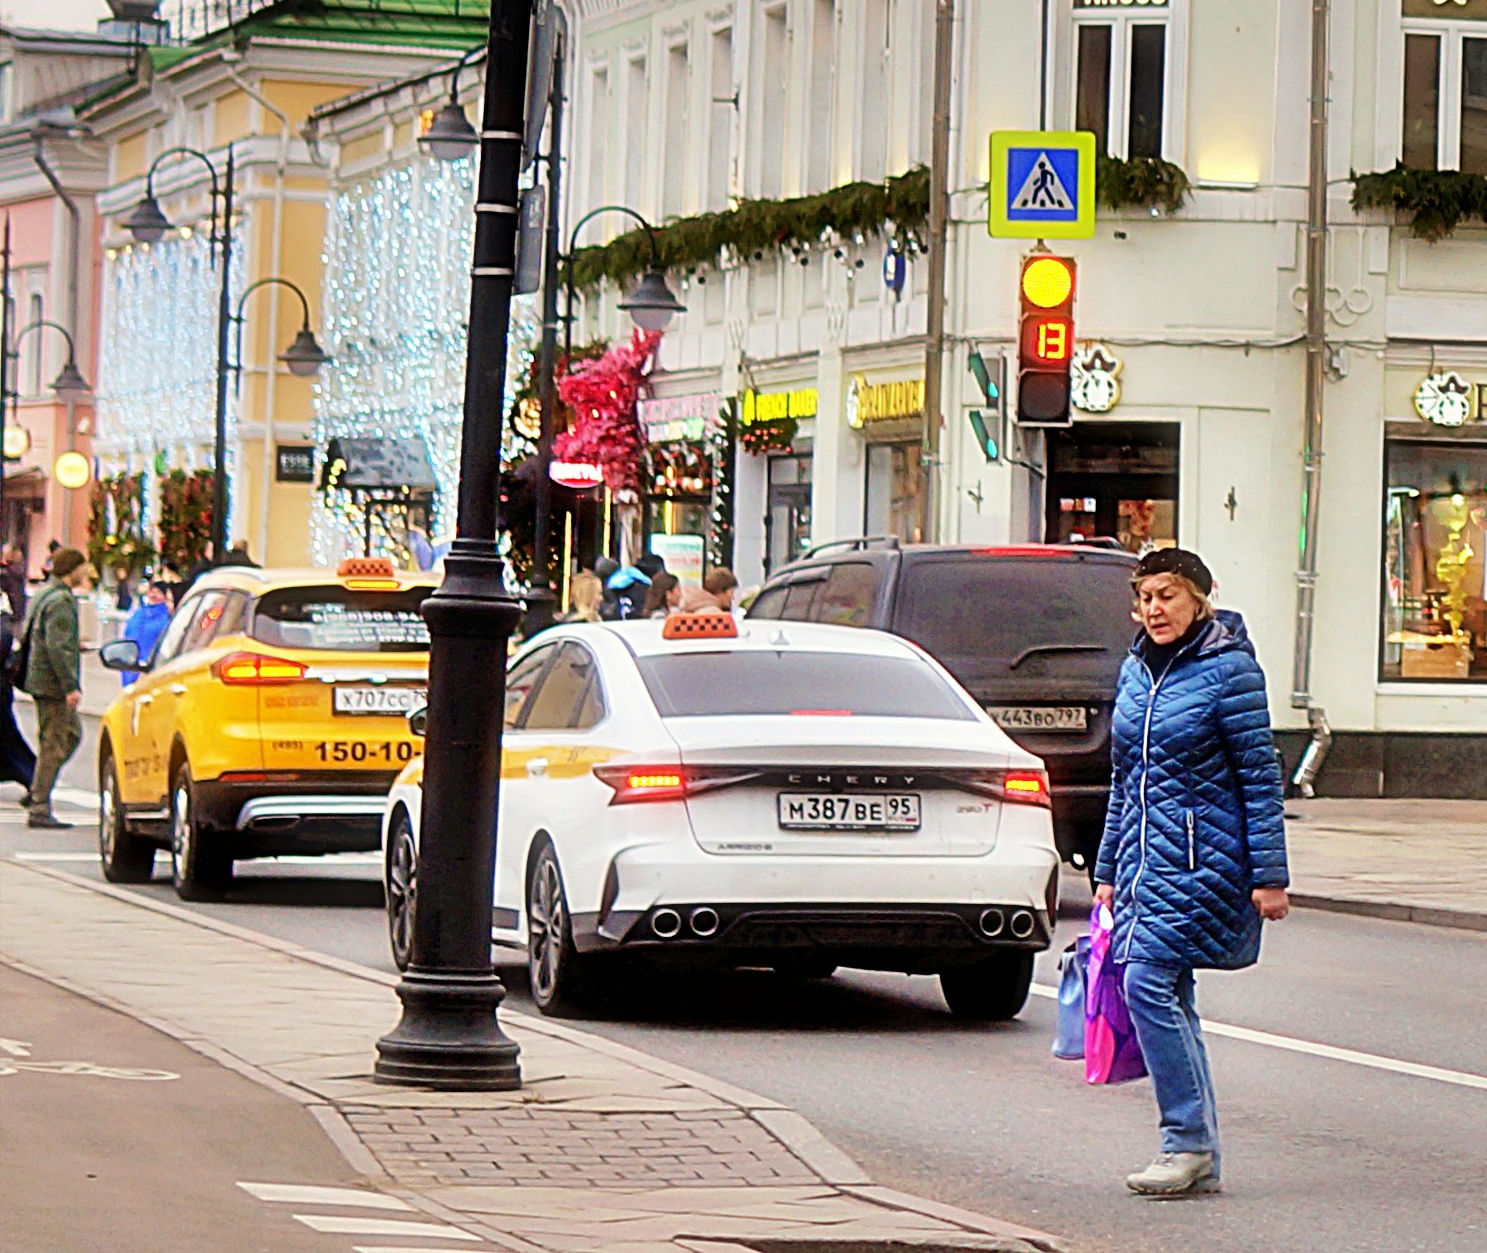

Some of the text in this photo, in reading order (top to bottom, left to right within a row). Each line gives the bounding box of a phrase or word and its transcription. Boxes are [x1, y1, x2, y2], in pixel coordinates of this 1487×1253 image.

[1038, 322, 1066, 359] 13
[1059, 708, 1082, 722] 797
[788, 774, 915, 785] CHERY
[889, 798, 911, 815] 95
